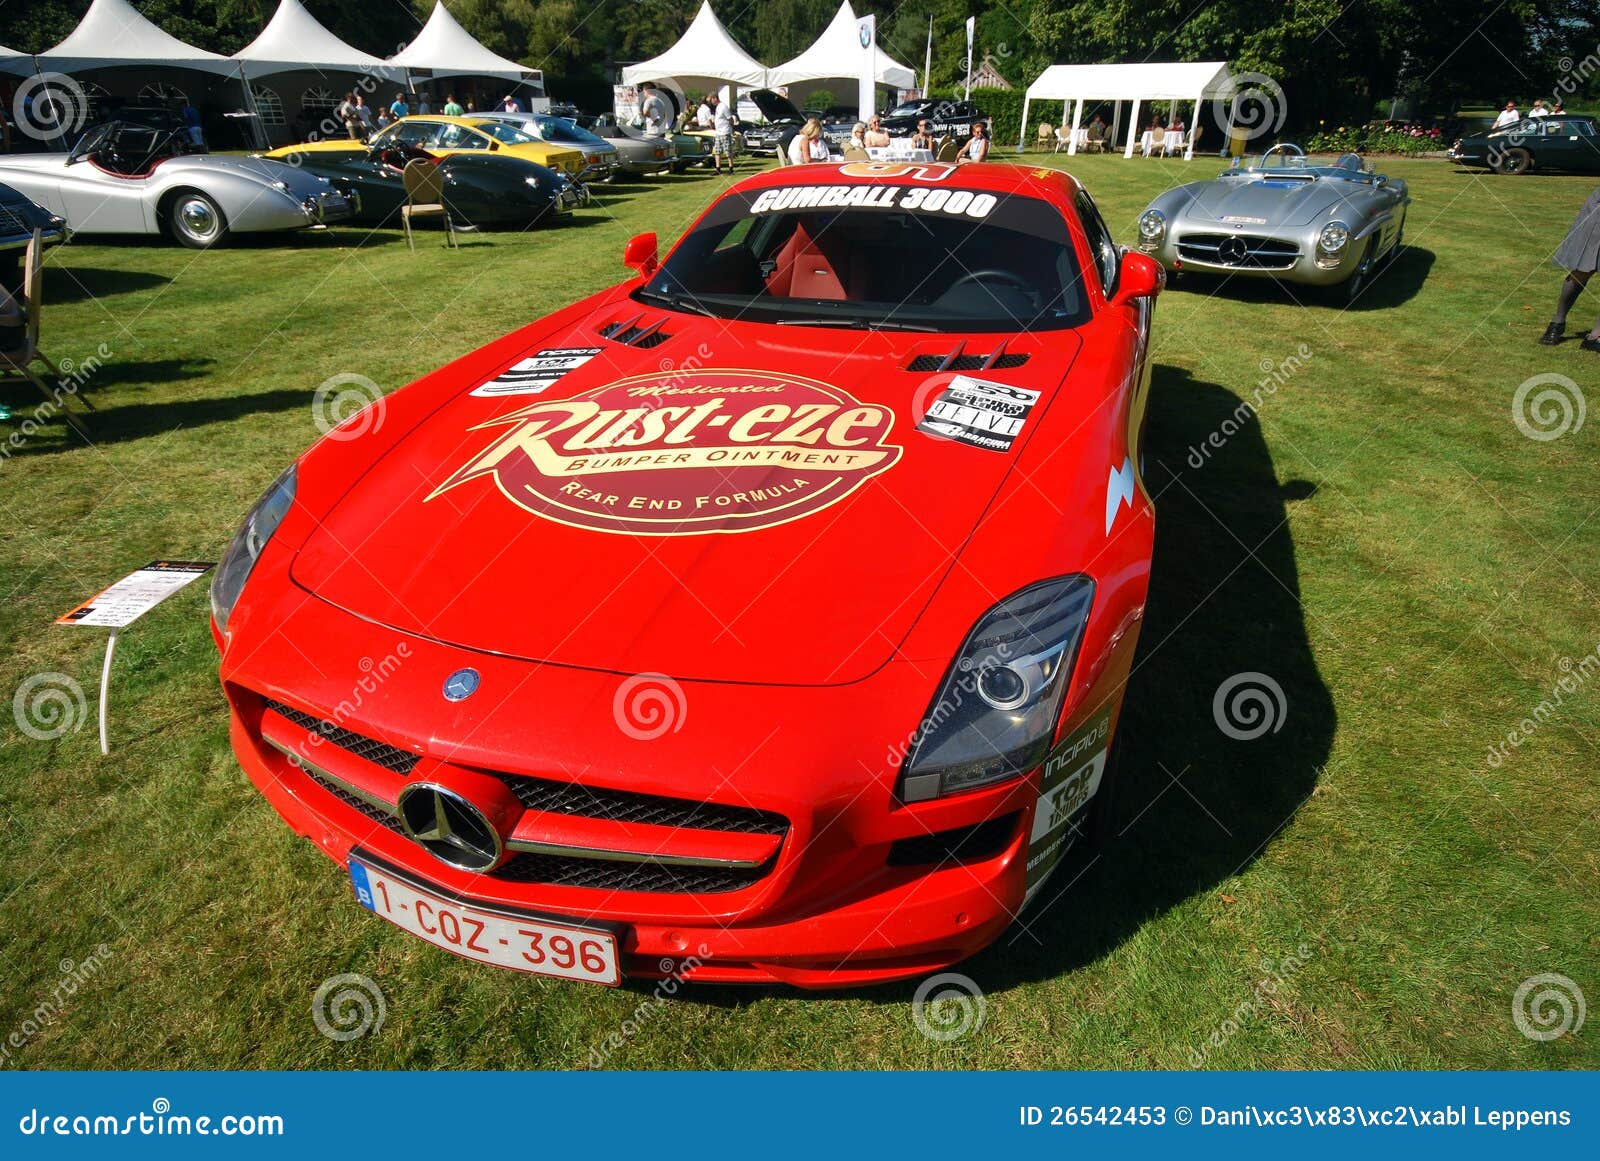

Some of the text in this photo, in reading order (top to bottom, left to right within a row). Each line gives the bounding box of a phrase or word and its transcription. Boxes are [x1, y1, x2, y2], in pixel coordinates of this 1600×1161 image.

[751, 186, 997, 218] GUMBALL 3000
[626, 383, 786, 398] Medicated
[564, 449, 860, 471] BUMPER OINTMENT
[559, 477, 811, 510] REAR END FORMULA
[1051, 762, 1095, 806] TOP
[357, 886, 371, 904] B
